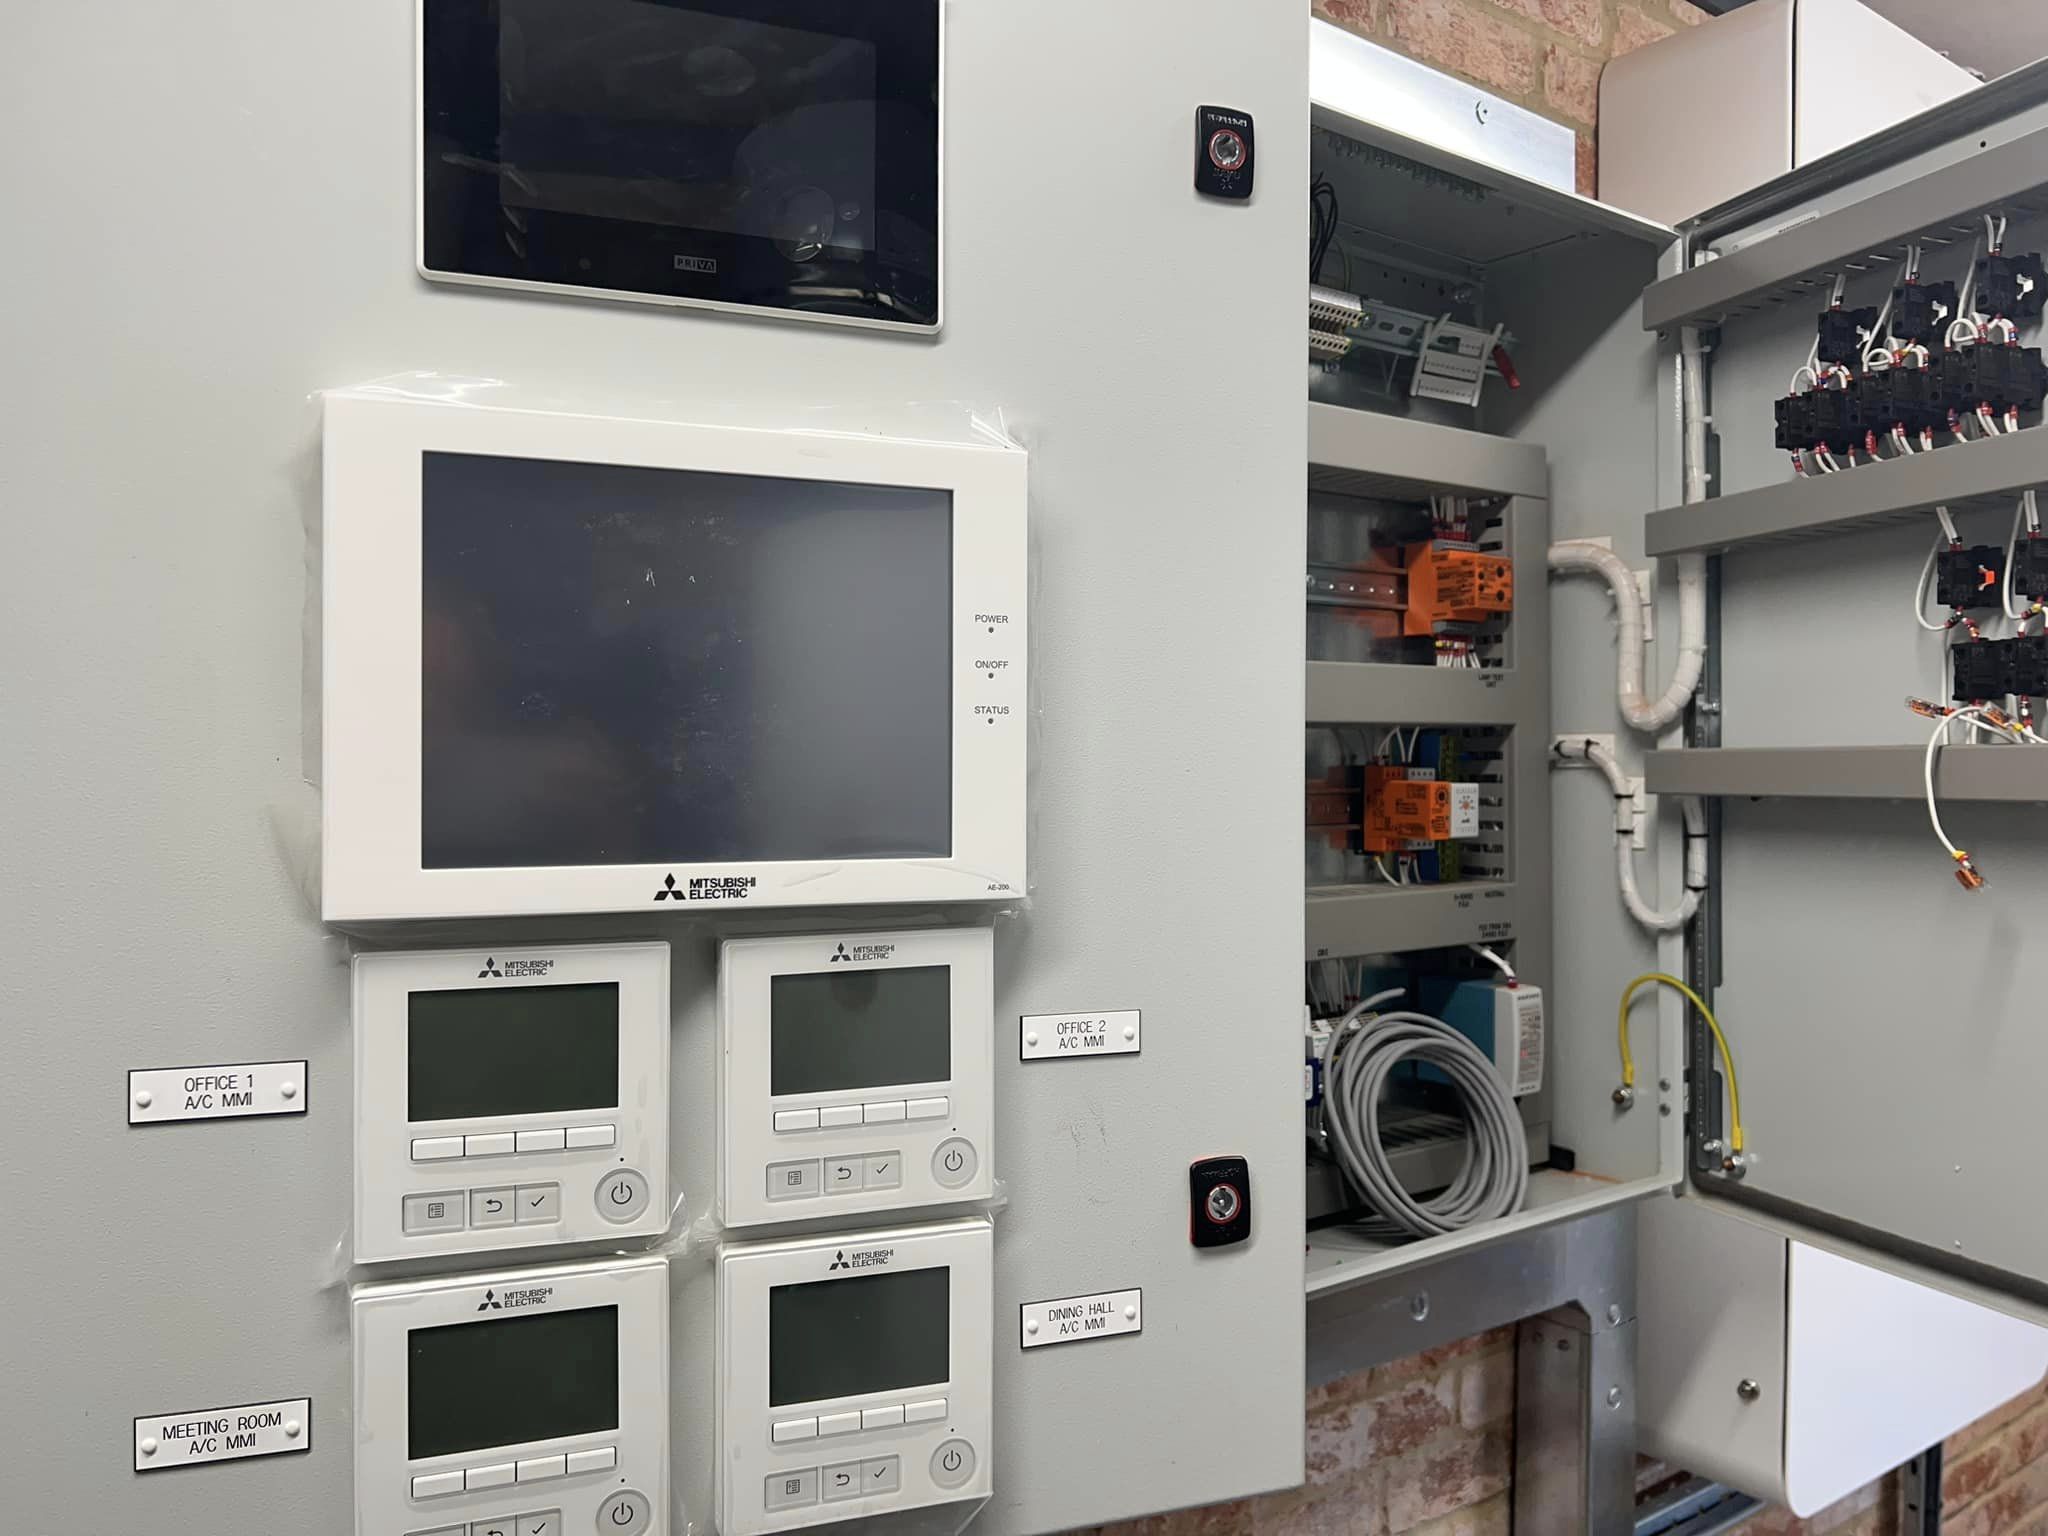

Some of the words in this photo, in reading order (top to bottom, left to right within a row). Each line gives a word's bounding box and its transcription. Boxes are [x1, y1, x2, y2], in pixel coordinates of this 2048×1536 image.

[676, 256, 715, 271] PRIVA
[975, 614, 1009, 624] POWER
[975, 660, 1009, 669] ON/OFF
[974, 705, 1009, 715] STATUS
[690, 877, 756, 888] MITSUBISHI
[987, 883, 1010, 891] AE-200
[690, 887, 748, 900] ELECTRIC
[853, 944, 895, 955] MITSUBISHI
[853, 952, 889, 961] ELECTRIC
[505, 959, 554, 970] MITSUBISHI
[505, 967, 548, 978] ELECTRIC
[1056, 1020, 1093, 1036] OFFICE
[1098, 1019, 1106, 1032] 2
[1058, 1036, 1079, 1049] A/C
[1083, 1033, 1105, 1048] MMI
[184, 1075, 238, 1093] OFFICE
[247, 1073, 253, 1088] 1
[184, 1094, 213, 1110] A/C
[222, 1092, 253, 1107] MMI
[852, 1249, 894, 1260] MITSUBISHI
[852, 1256, 889, 1268] ELECTRIC
[504, 1287, 553, 1301] MITSUBISHI
[504, 1296, 547, 1308] ELECTRIC
[1048, 1304, 1084, 1322] DINING
[1088, 1301, 1115, 1316] HALL
[1059, 1318, 1079, 1335] A/C
[1084, 1316, 1106, 1331] MMI
[162, 1418, 229, 1441] MEETING
[237, 1411, 282, 1431] ROOM
[189, 1437, 217, 1455] A/C
[226, 1433, 256, 1451] MMI
